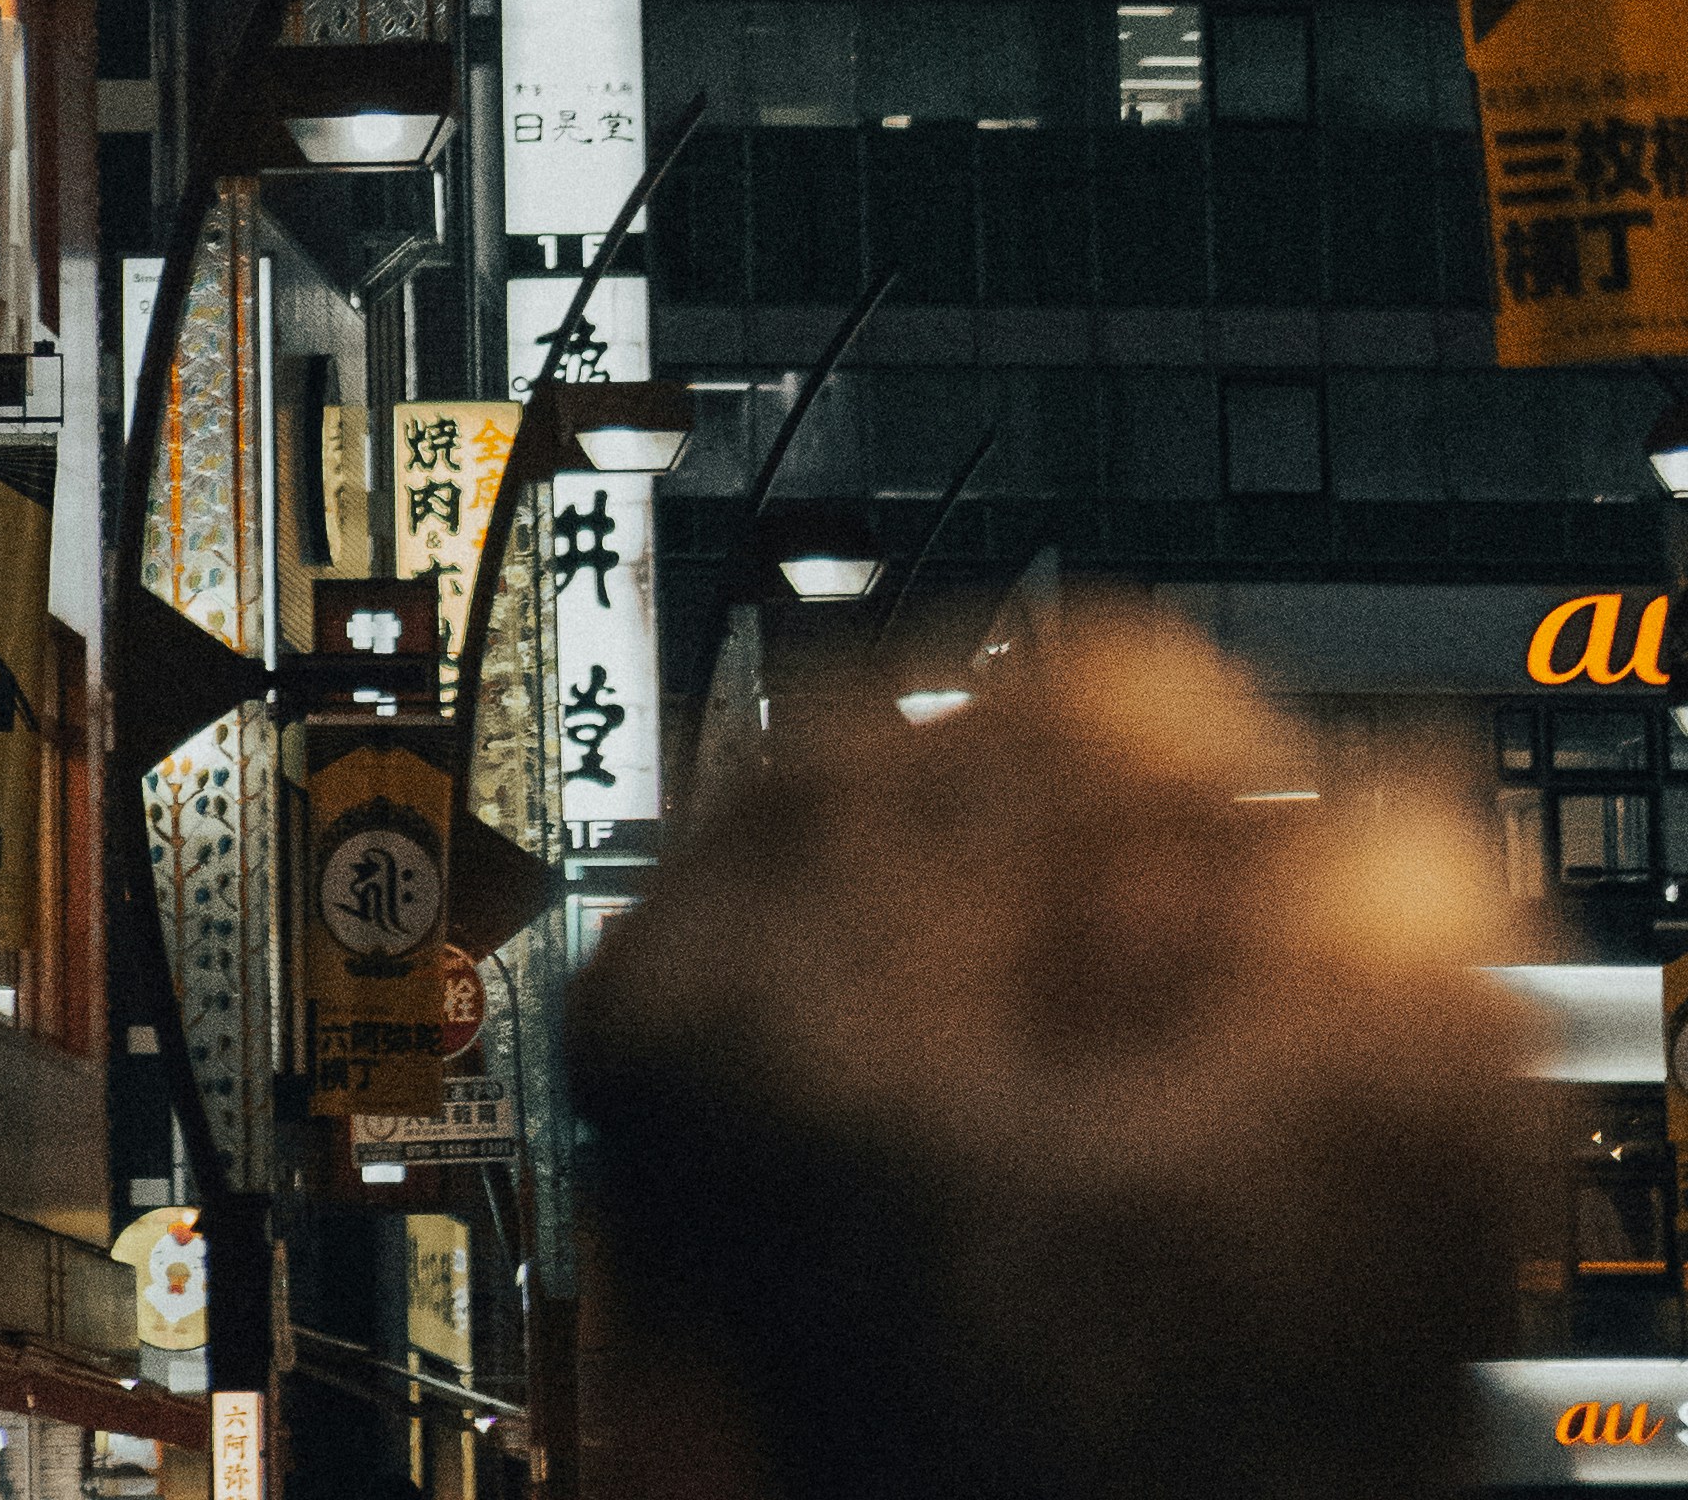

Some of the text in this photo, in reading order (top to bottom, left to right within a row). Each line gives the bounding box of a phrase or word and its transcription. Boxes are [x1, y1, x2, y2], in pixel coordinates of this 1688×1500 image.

[1526, 591, 1670, 688] au
[565, 821, 615, 850] 1F
[222, 1404, 251, 1500] 六阿弥
[1554, 1400, 1666, 1447] au
